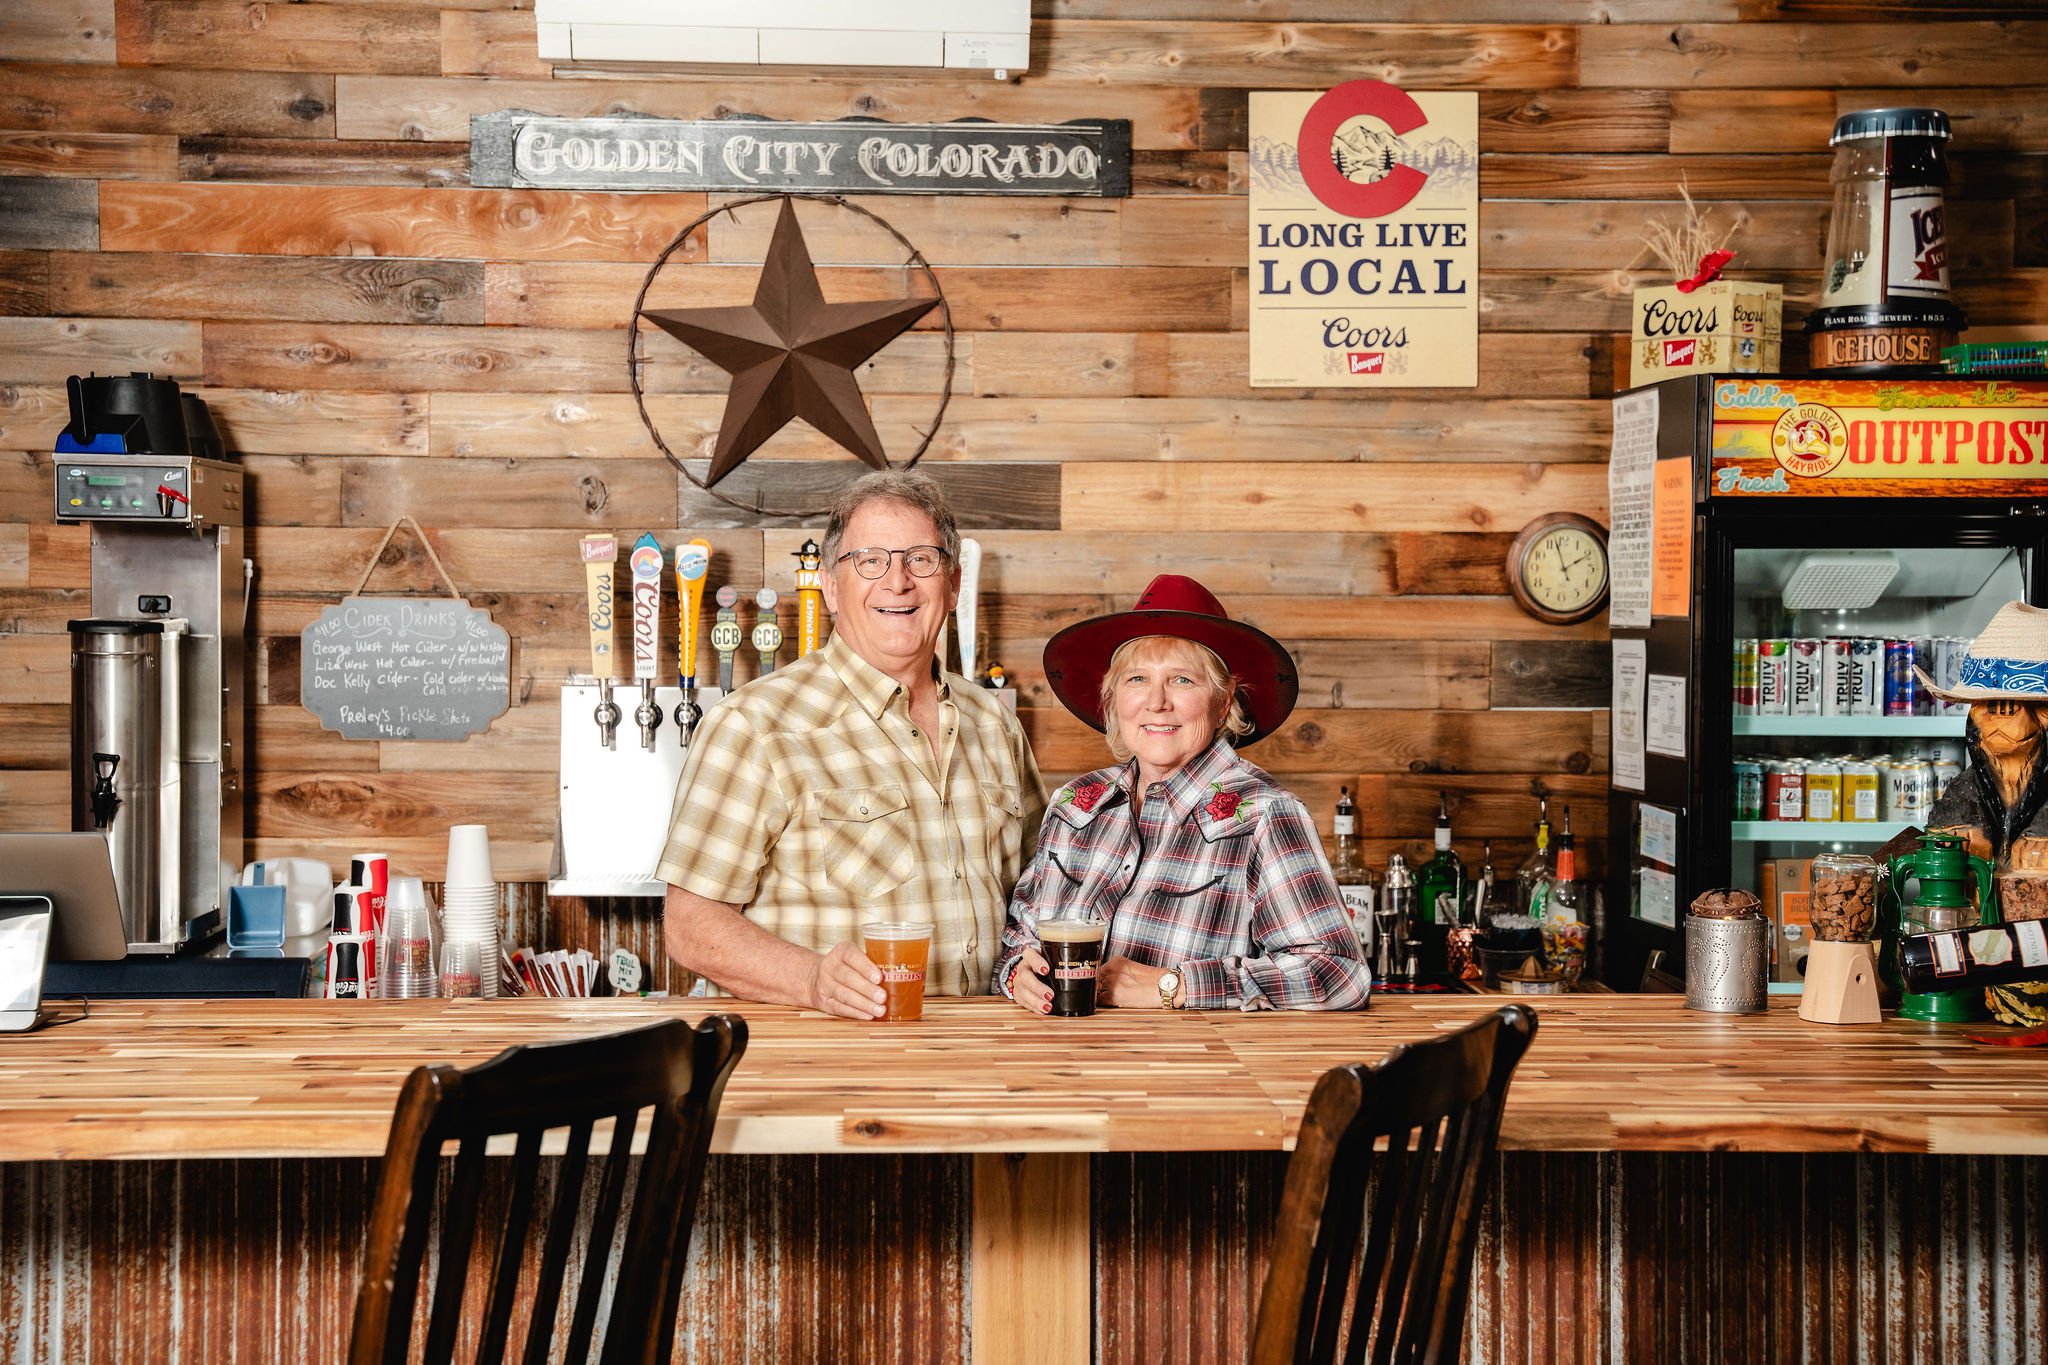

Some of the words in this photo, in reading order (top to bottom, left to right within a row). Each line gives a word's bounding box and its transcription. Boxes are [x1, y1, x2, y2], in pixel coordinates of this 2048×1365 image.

[518, 131, 706, 176] GOLDEN
[723, 135, 841, 184] CITY
[858, 137, 1100, 185] COLORADO
[1257, 223, 1364, 248] LONG
[1376, 223, 1467, 248] LIVE
[1258, 259, 1466, 295] LOCAL
[1643, 299, 1719, 337] Coors
[1733, 304, 1763, 323] Coors
[1873, 314, 1912, 323] REWERY
[1322, 316, 1410, 348] Coors
[1666, 341, 1695, 365] Banquet
[1826, 334, 1932, 366] ICEHOUSE
[1350, 354, 1383, 373] Banquet
[1972, 382, 2018, 405] the
[1779, 413, 1798, 431] THE
[1800, 408, 1839, 431] GOLDEN
[1785, 456, 1833, 473] HAYRIDE
[1717, 467, 1789, 492] Fresh
[799, 572, 822, 587] IPA
[590, 571, 612, 631] Coors
[635, 582, 659, 663] Coors
[713, 627, 740, 645] GCB
[754, 629, 780, 646] GCB
[314, 675, 337, 689] Doc
[344, 672, 371, 694] Kelly
[1763, 661, 1776, 705] TRULY
[1796, 660, 1810, 705] TRULY
[1836, 661, 1849, 706] TRULY
[1851, 661, 1864, 705] TRULY
[1346, 894, 1368, 911] BEAM
